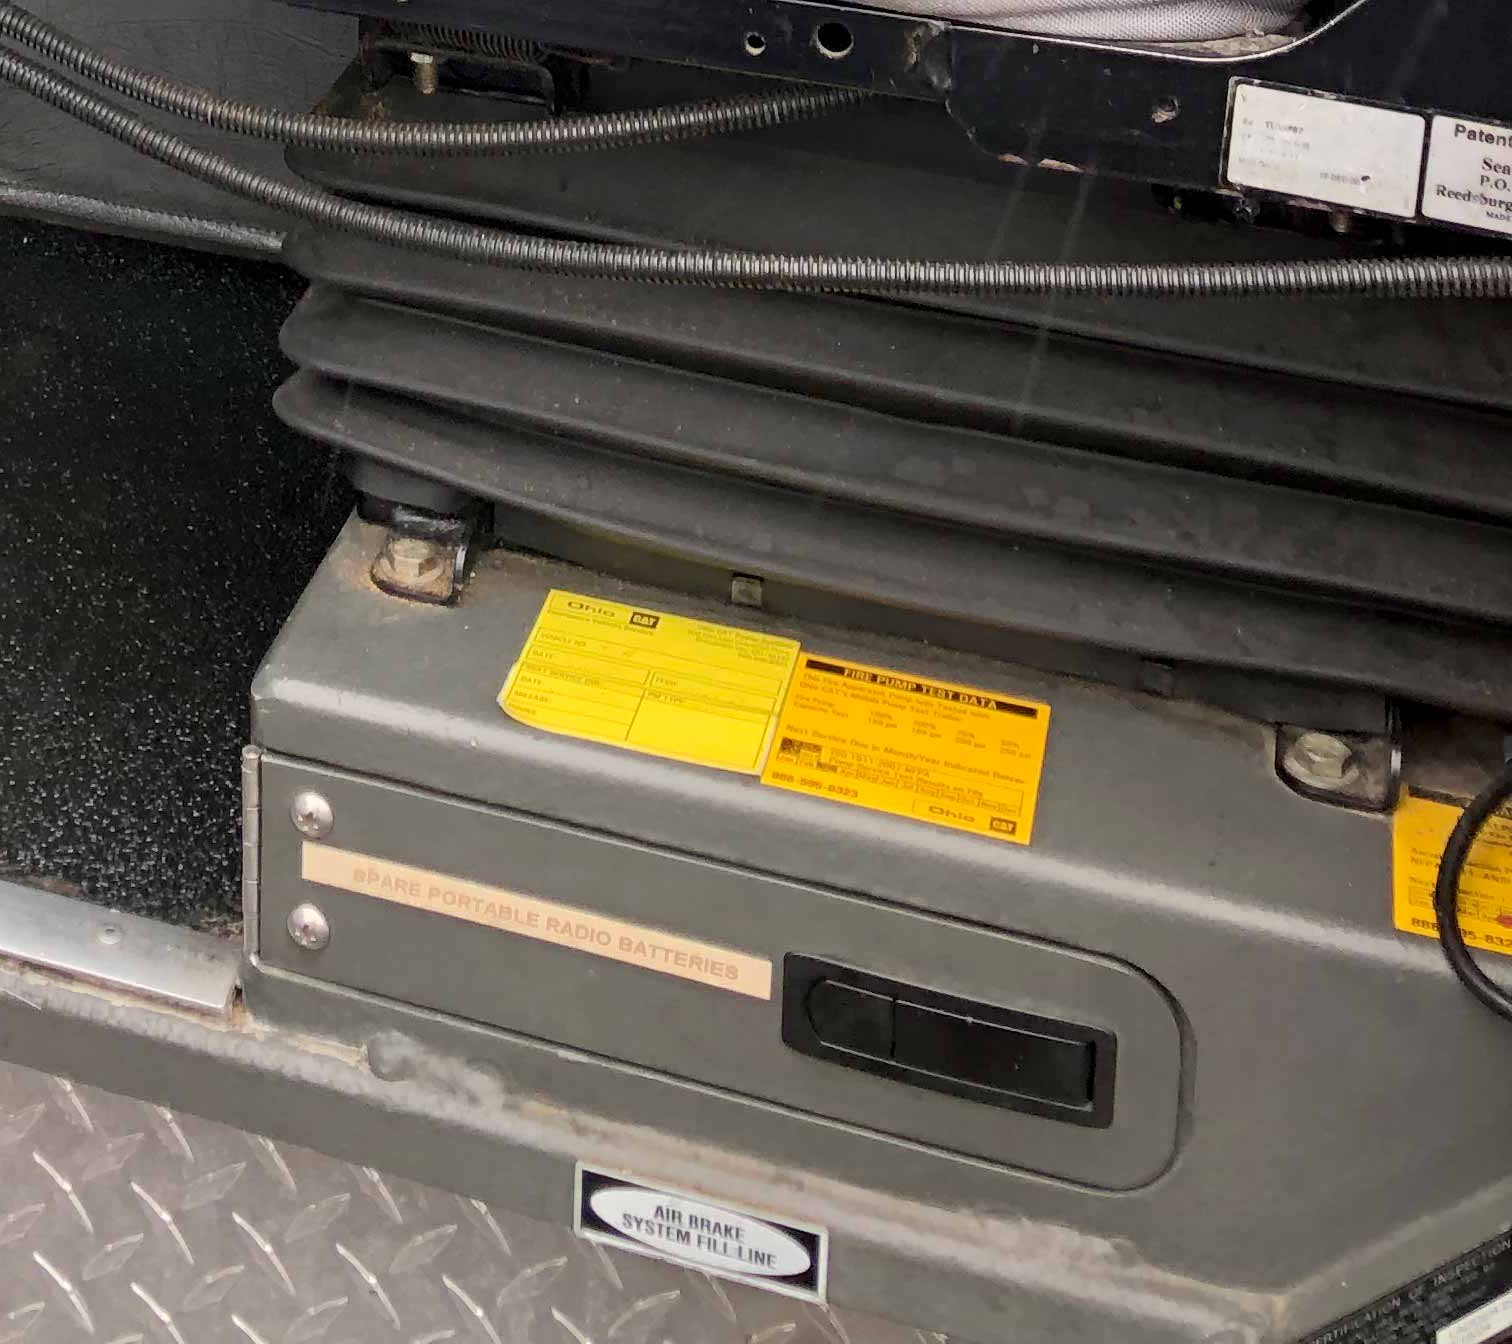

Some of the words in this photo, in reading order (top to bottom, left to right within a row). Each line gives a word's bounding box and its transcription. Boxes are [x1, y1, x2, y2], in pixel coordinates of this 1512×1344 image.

[567, 600, 616, 619] Ohio
[631, 614, 658, 628] CAT
[843, 668, 874, 682] FIRE
[876, 674, 918, 692] PUMP
[920, 683, 954, 701] TEST
[959, 691, 999, 710] DATA
[927, 804, 976, 824] Ohio
[353, 867, 421, 897] SPARE
[427, 886, 540, 929] PORTABLE
[545, 916, 612, 947] RADIO
[618, 934, 740, 982] BATTERIES
[621, 1212, 691, 1248] SYSTEM
[695, 1232, 731, 1258] FILL
[737, 1248, 778, 1271] LINE
[653, 1204, 683, 1224] AIR
[688, 1214, 746, 1245] BRAKE
